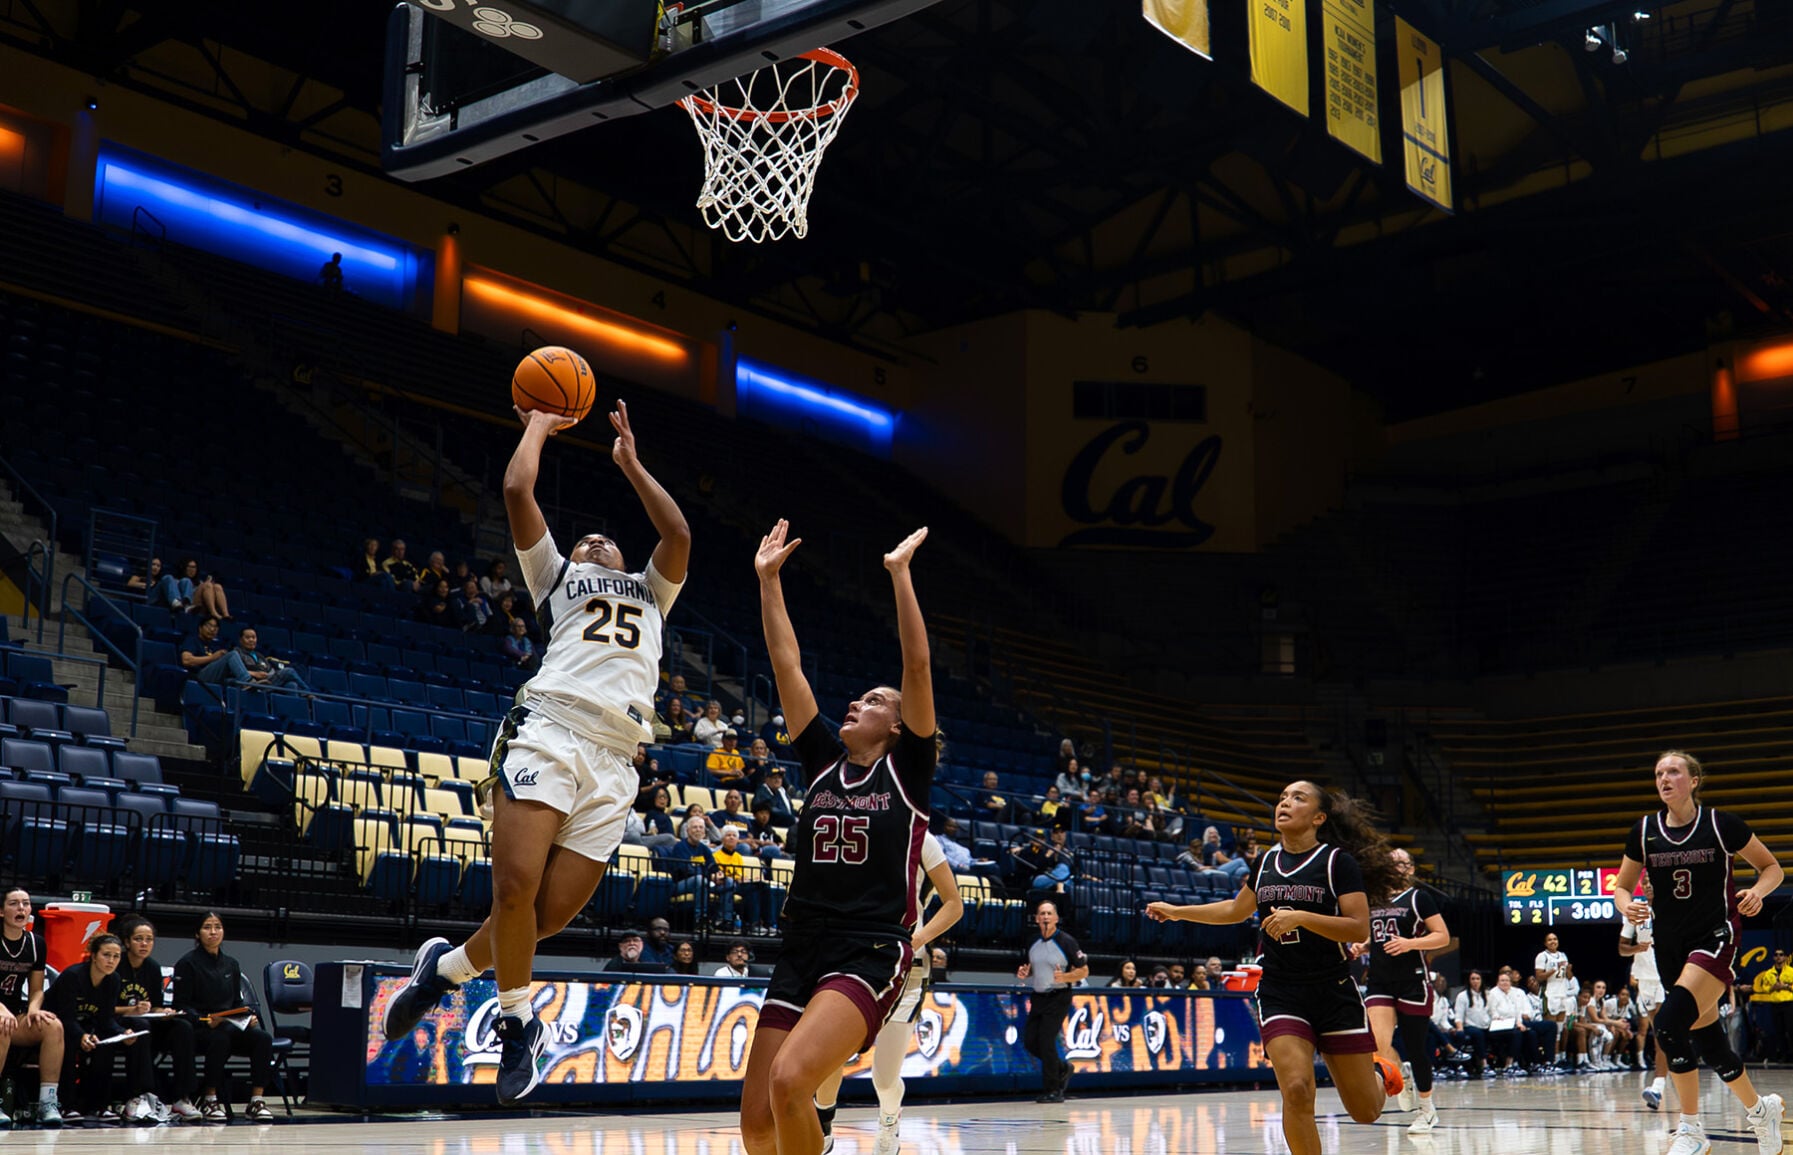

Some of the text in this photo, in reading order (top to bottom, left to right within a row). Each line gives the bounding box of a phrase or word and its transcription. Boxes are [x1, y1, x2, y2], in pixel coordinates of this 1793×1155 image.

[324, 174, 343, 197] 3
[651, 290, 666, 310] 4
[1129, 356, 1148, 374] 6
[874, 366, 887, 385] 5
[1622, 377, 1636, 394] 7
[1058, 420, 1222, 549] Cal
[582, 597, 644, 650] 25
[513, 767, 540, 787] Cal
[812, 814, 870, 865] 25
[1506, 871, 1568, 897] Cal 42
[1577, 870, 1594, 879] PER
[1672, 868, 1692, 900] 3
[1580, 879, 1592, 895] 2
[1508, 899, 1544, 909] TOL FLS
[1571, 901, 1614, 920] 3:00
[1510, 909, 1543, 924] 3 2
[1371, 917, 1401, 943] 24
[283, 963, 301, 979] Cal
[0, 974, 18, 996] 4
[550, 1021, 579, 1044] VS
[1066, 1007, 1130, 1060] Cal VS
